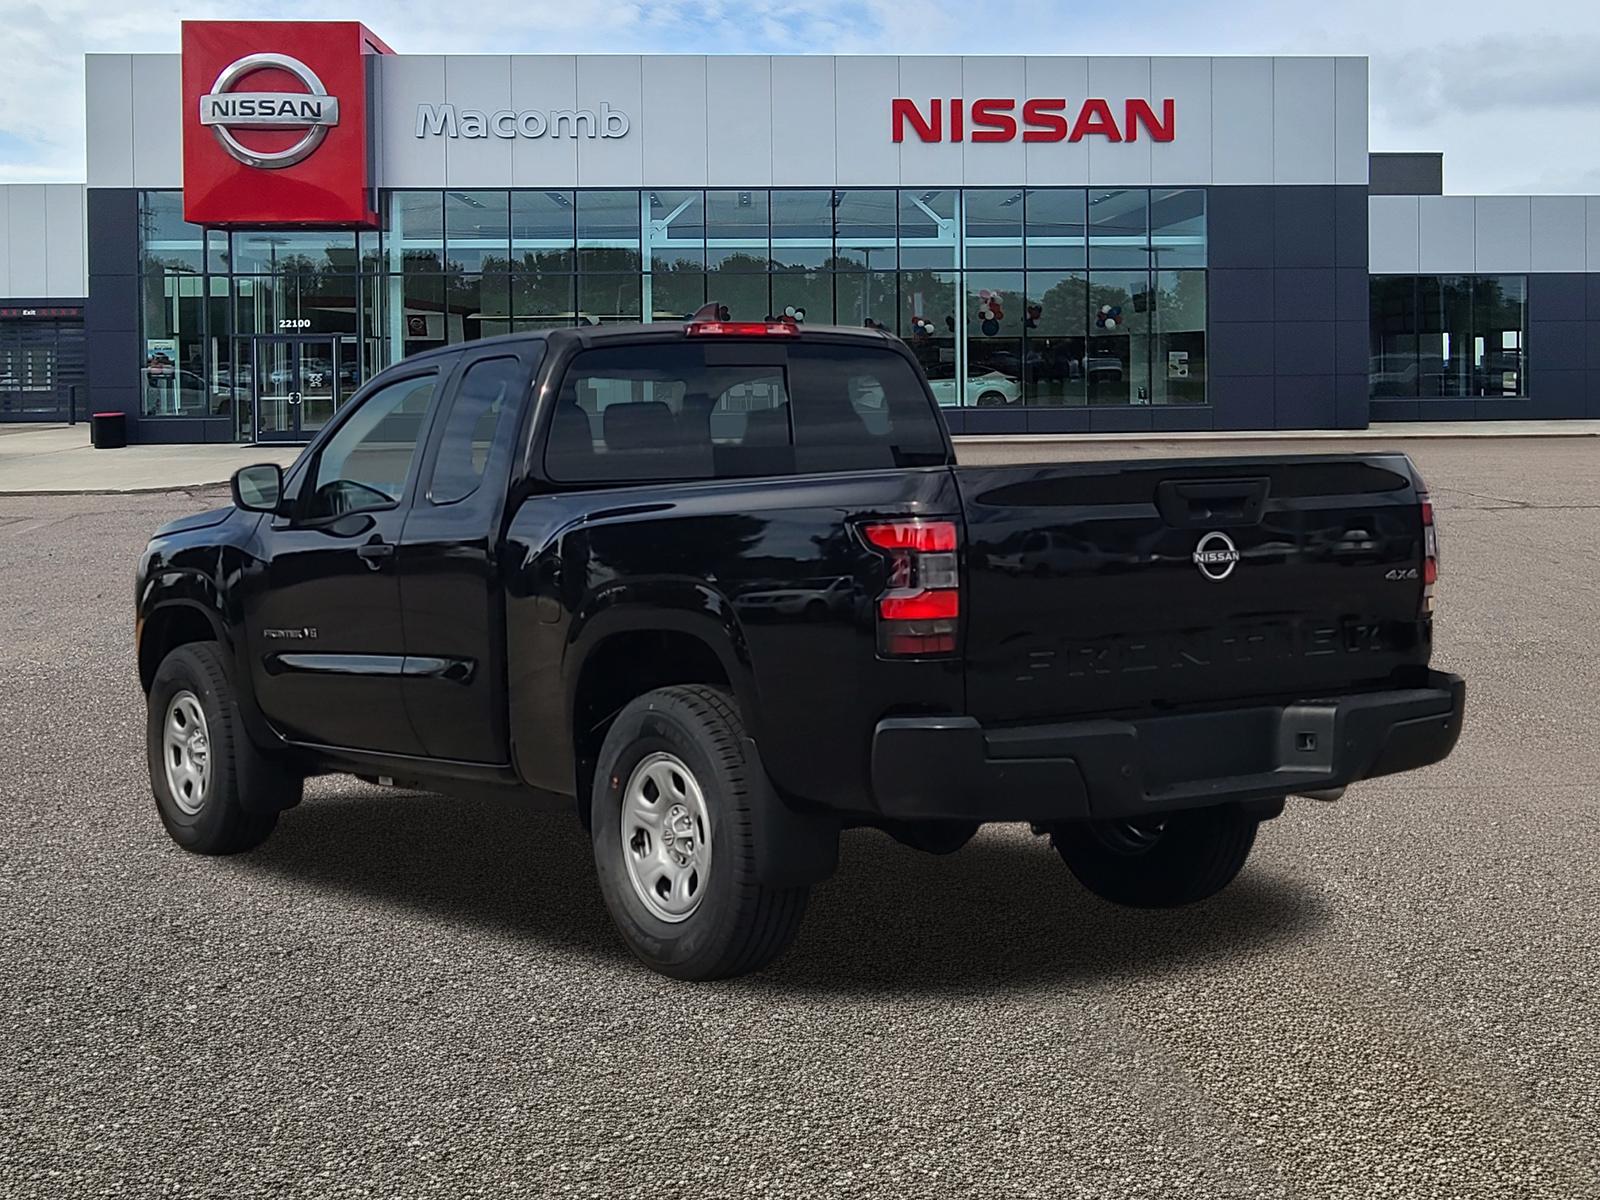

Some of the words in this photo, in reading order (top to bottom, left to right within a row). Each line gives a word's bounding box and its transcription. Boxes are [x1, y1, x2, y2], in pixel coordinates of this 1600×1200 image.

[211, 100, 322, 118] NISSAN
[415, 102, 630, 138] Macomb
[892, 98, 1175, 143] NISSAN
[279, 319, 311, 328] 22100
[1194, 551, 1240, 563] NISSAN
